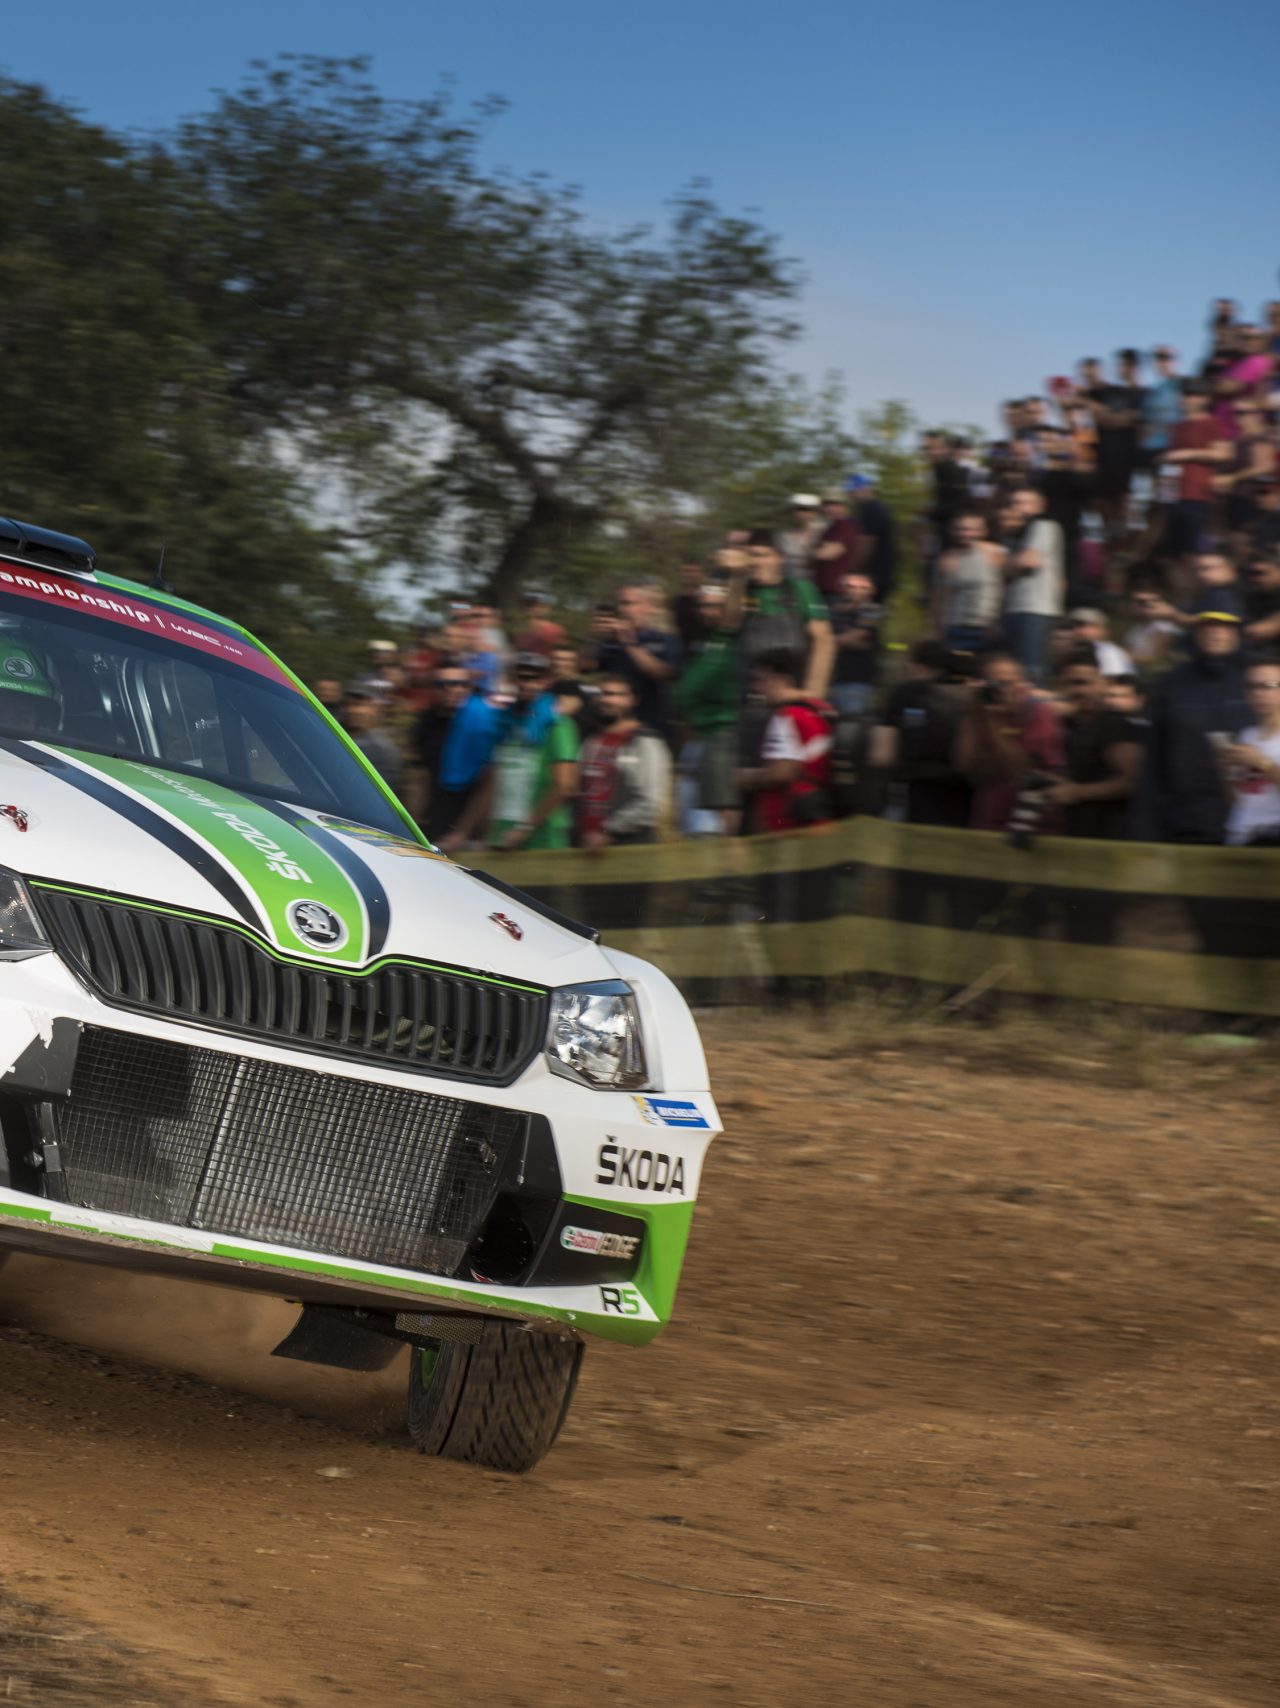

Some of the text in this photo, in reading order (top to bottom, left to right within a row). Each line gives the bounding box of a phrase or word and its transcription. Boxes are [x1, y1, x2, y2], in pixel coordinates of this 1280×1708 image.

[211, 811, 314, 884] ŠKODA
[595, 1134, 685, 1196] ŠKODA
[598, 1285, 640, 1315] R5
